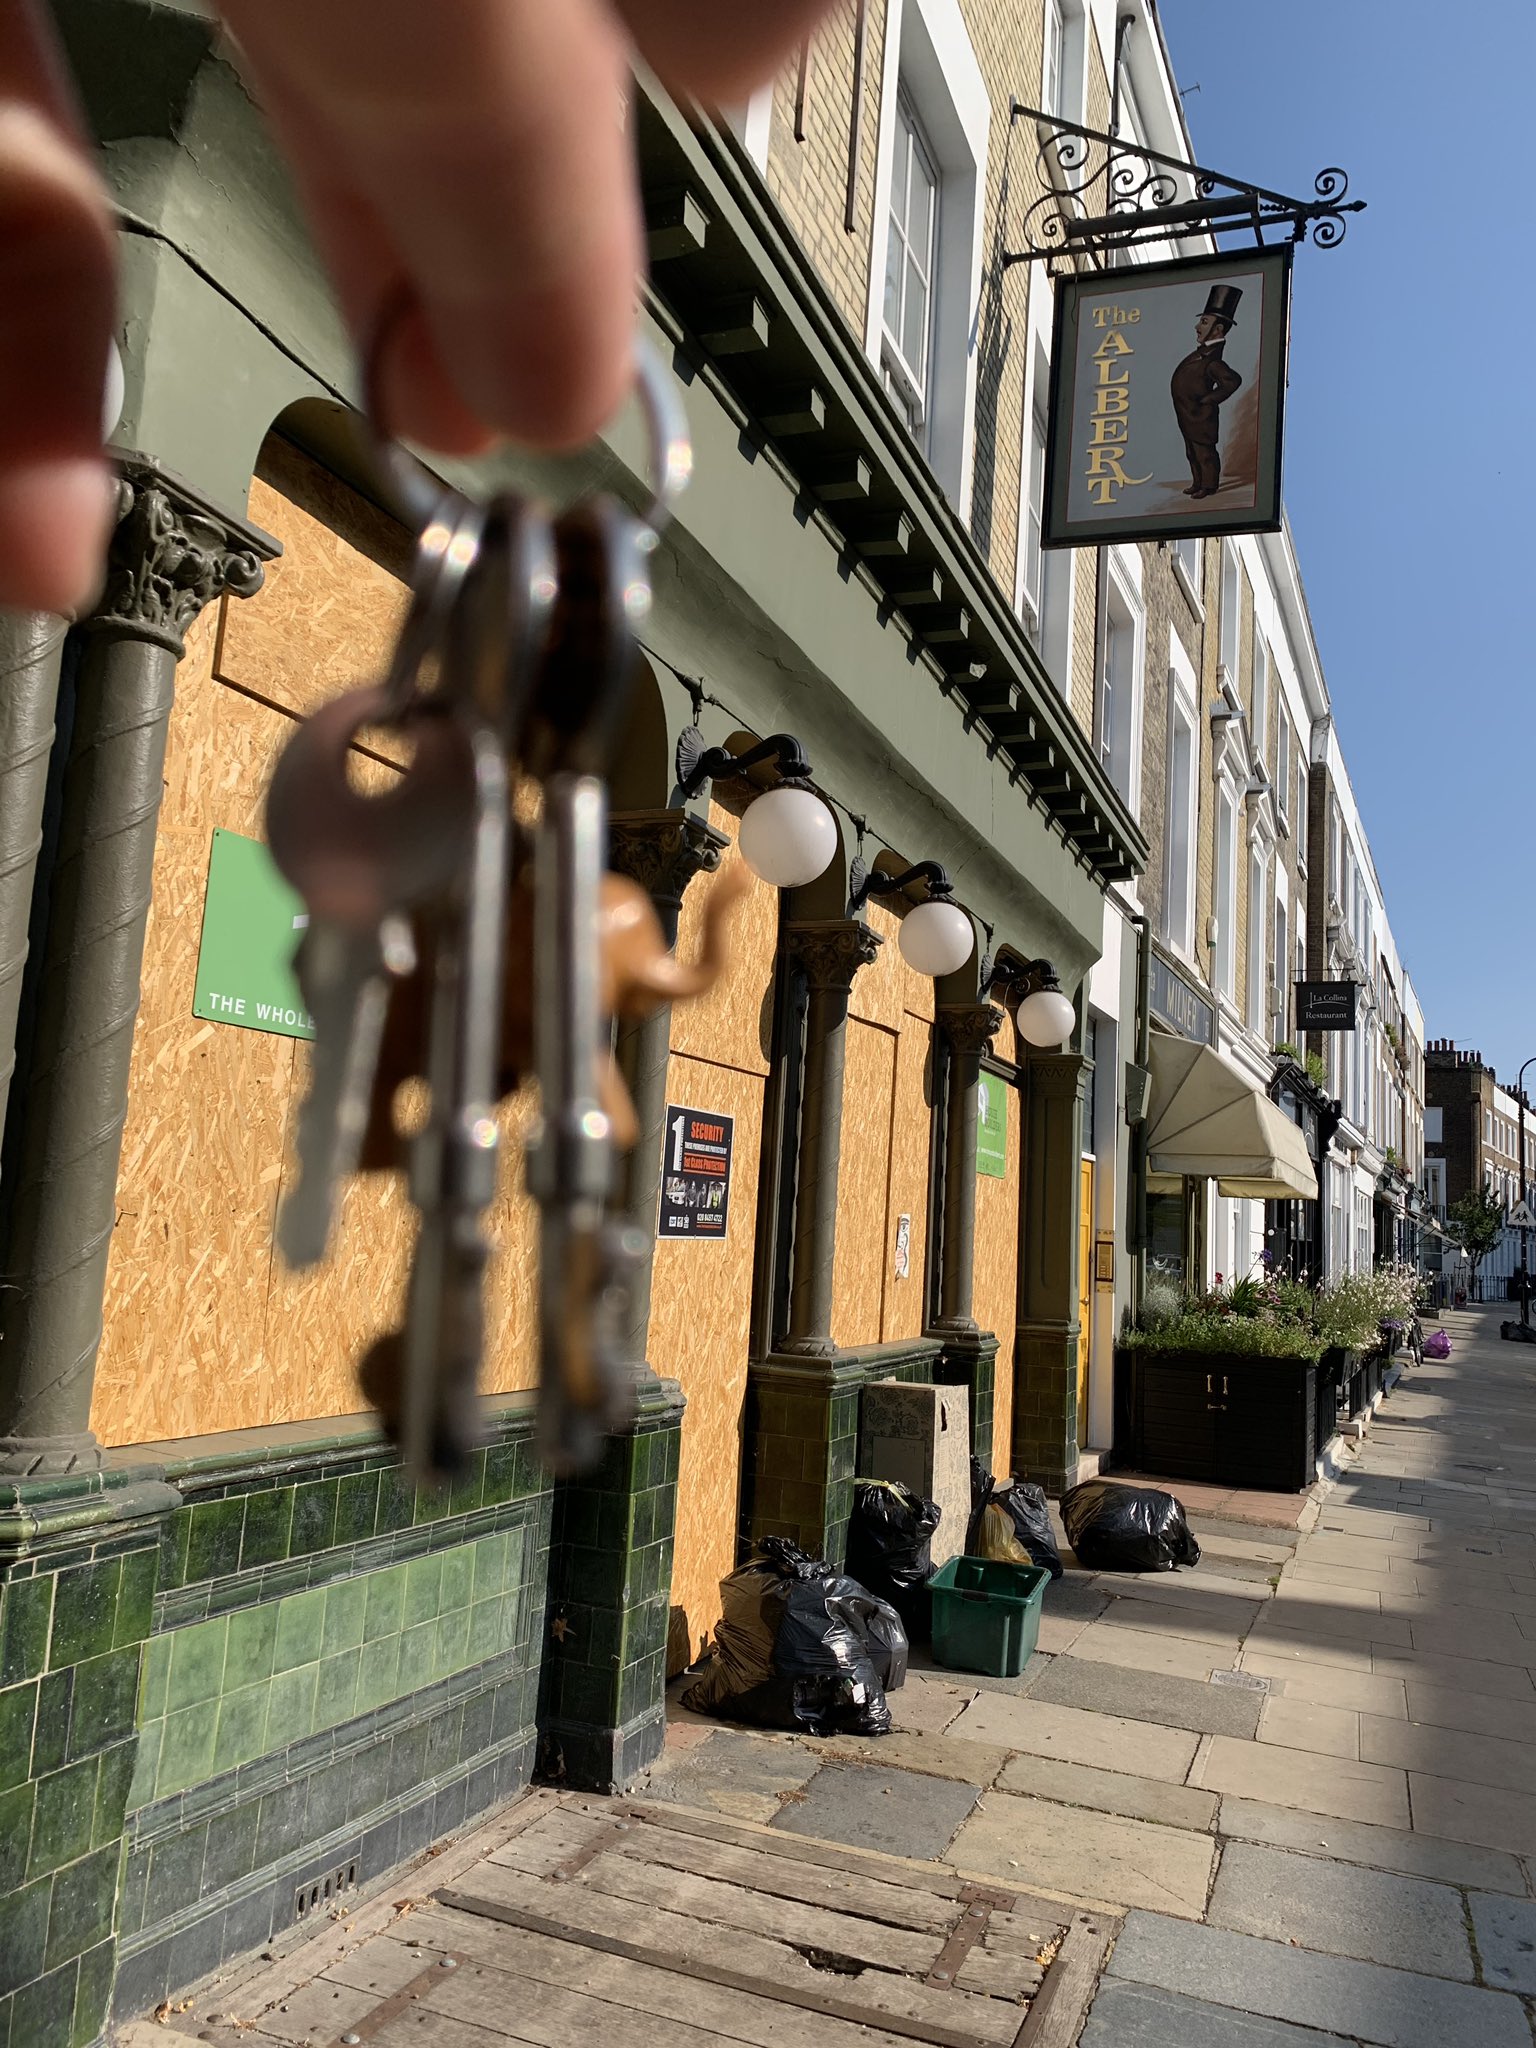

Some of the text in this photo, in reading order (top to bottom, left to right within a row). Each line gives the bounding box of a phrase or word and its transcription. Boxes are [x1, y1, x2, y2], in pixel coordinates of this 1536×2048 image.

[1092, 304, 1141, 328] The
[1085, 330, 1154, 505] ALBERT
[209, 993, 316, 1030] THE WHOLE
[1167, 976, 1197, 1036] MILNER
[1306, 1011, 1347, 1019] Restaurant
[672, 1115, 685, 1171] 1
[691, 1121, 724, 1142] SECURITY
